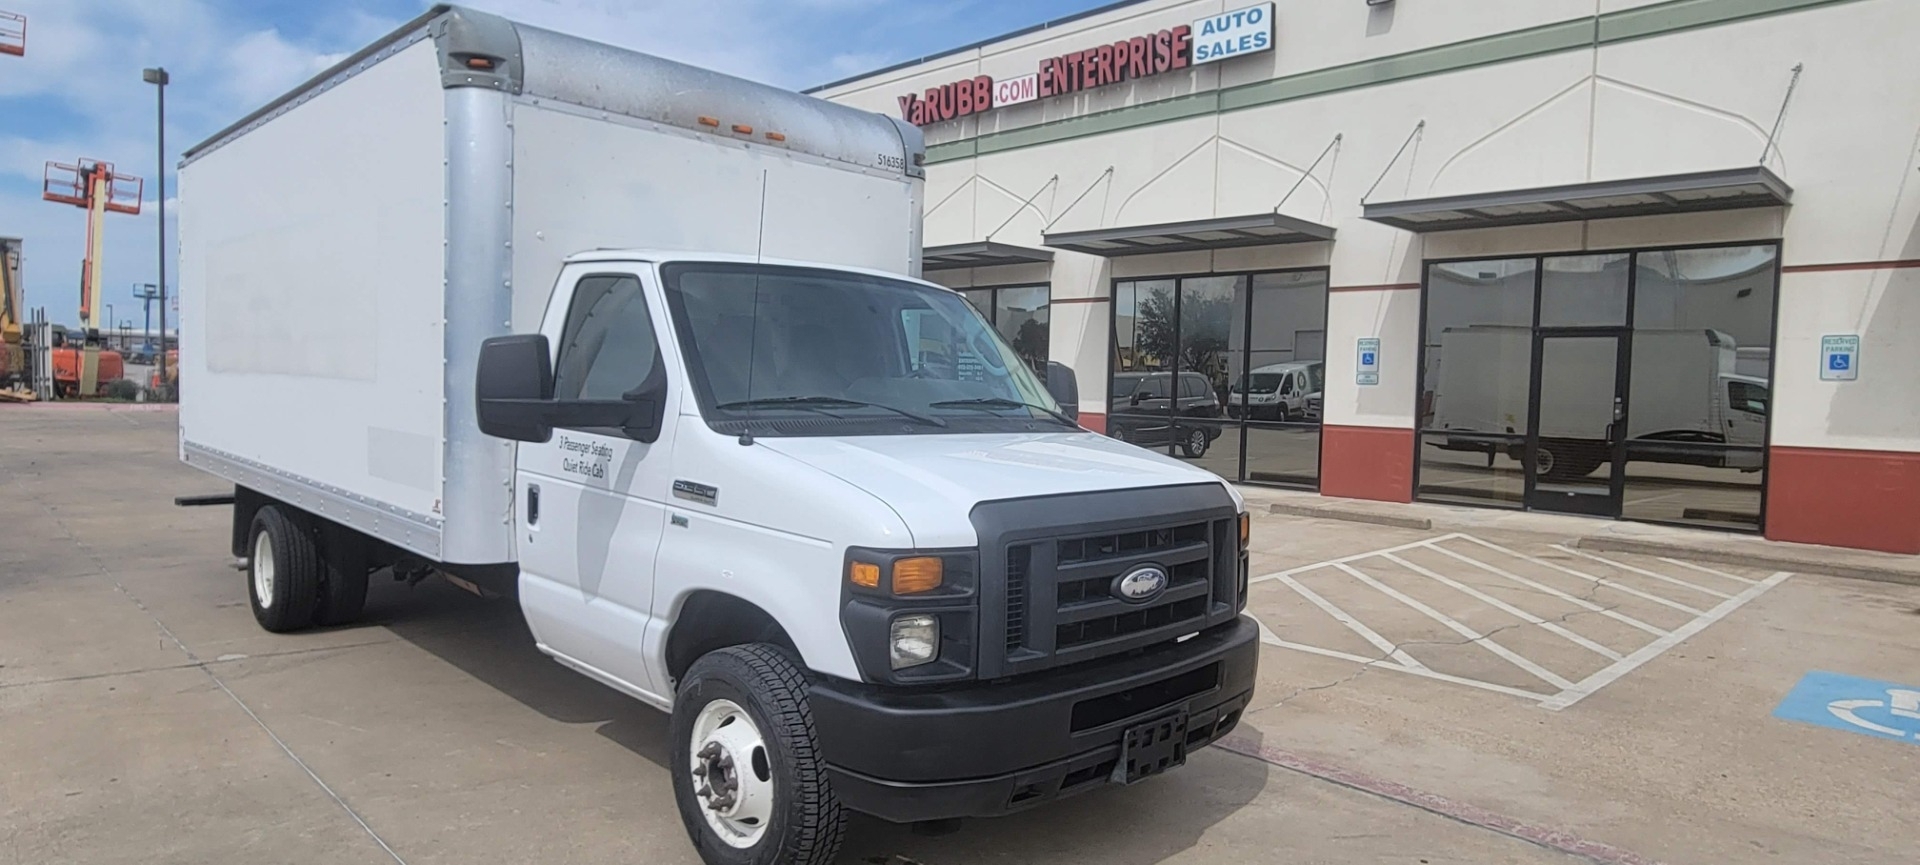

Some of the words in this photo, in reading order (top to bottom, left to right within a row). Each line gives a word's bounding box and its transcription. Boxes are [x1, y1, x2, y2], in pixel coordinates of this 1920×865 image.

[1201, 8, 1263, 37] AUTO
[1196, 31, 1268, 61] SALES
[898, 75, 993, 127] YaRUBB
[1039, 25, 1193, 98] ENTERPRISE
[877, 153, 904, 170] 516358
[564, 436, 591, 457] Passenger
[591, 441, 613, 462] Seating
[563, 457, 578, 474] Quiet
[579, 460, 591, 477] Ride
[592, 463, 604, 479] Cab
